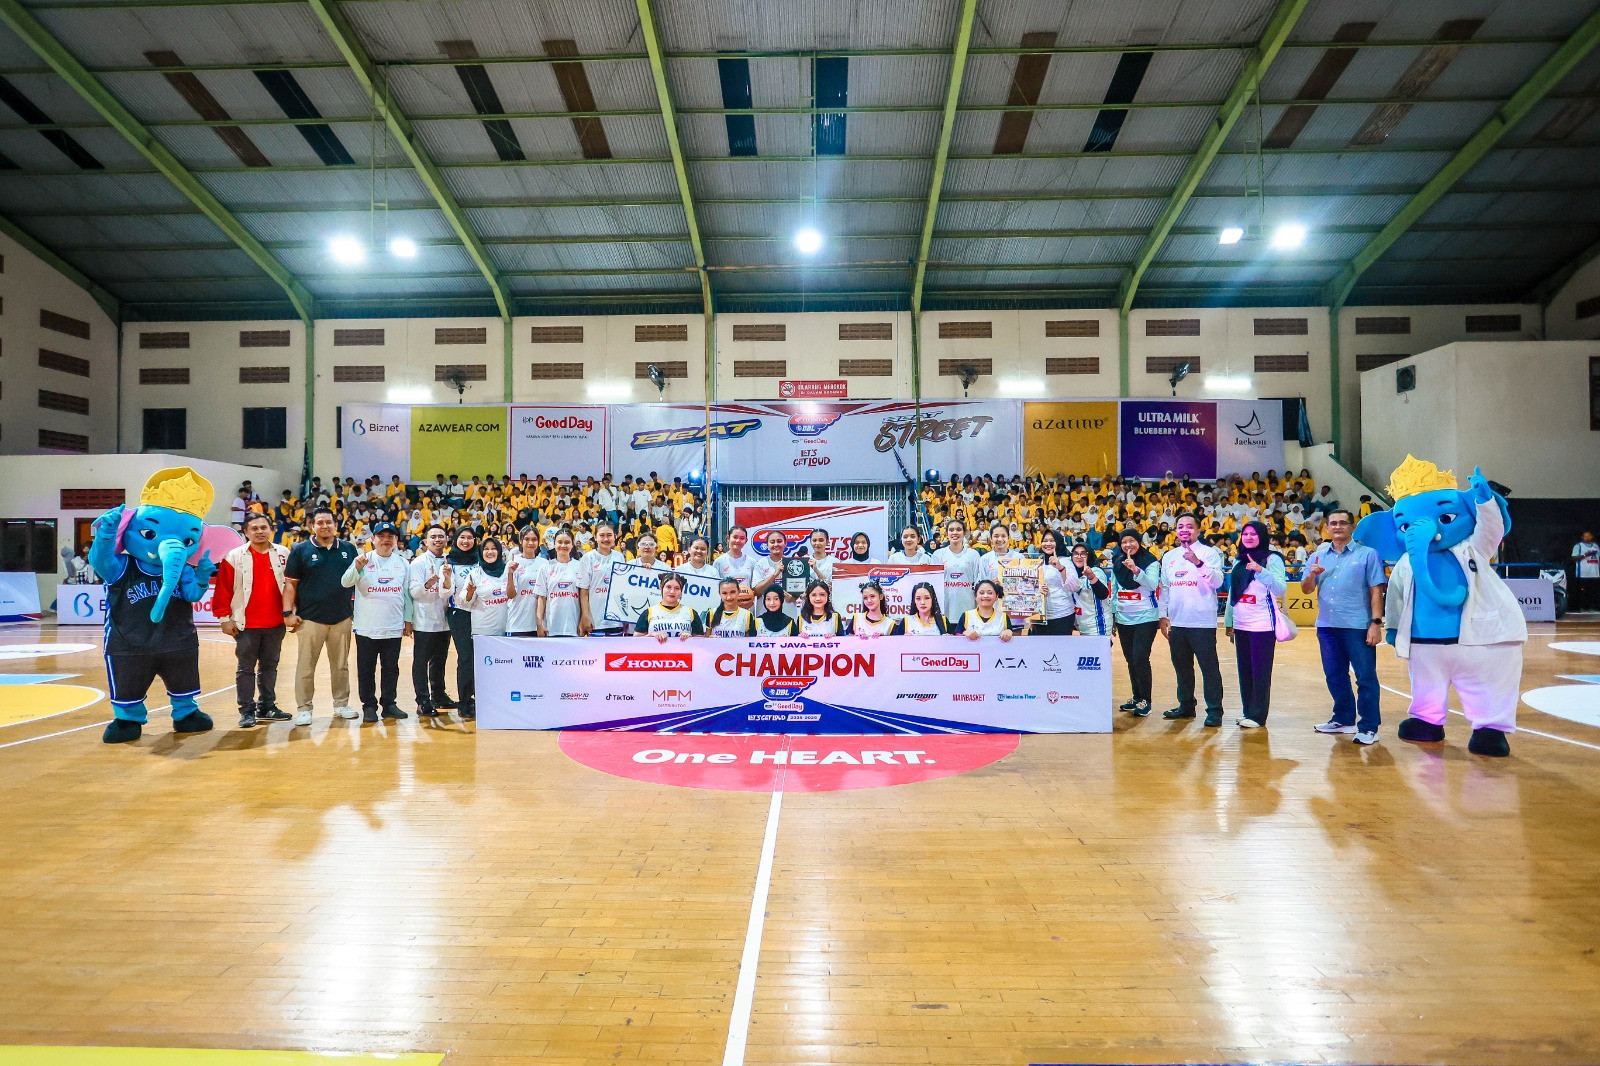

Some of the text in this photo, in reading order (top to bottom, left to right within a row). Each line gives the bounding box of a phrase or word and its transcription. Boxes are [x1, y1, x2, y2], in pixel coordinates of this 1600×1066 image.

[1138, 412, 1200, 423] ULTRA MILK
[369, 423, 400, 432] Biznet
[1134, 427, 1206, 436] BLUEBERRY BLAST
[874, 415, 994, 453] STREET
[1234, 437, 1266, 446] Jackson
[801, 449, 817, 457] LET'S
[628, 574, 711, 598] CHAION
[626, 660, 689, 669] HONDA
[714, 653, 875, 677] CHAMPION
[1077, 656, 1101, 667] DBL
[652, 689, 692, 701] MPM
[896, 692, 938, 700] proteam
[952, 693, 986, 701] MAINBASKET
[632, 749, 738, 764] One
